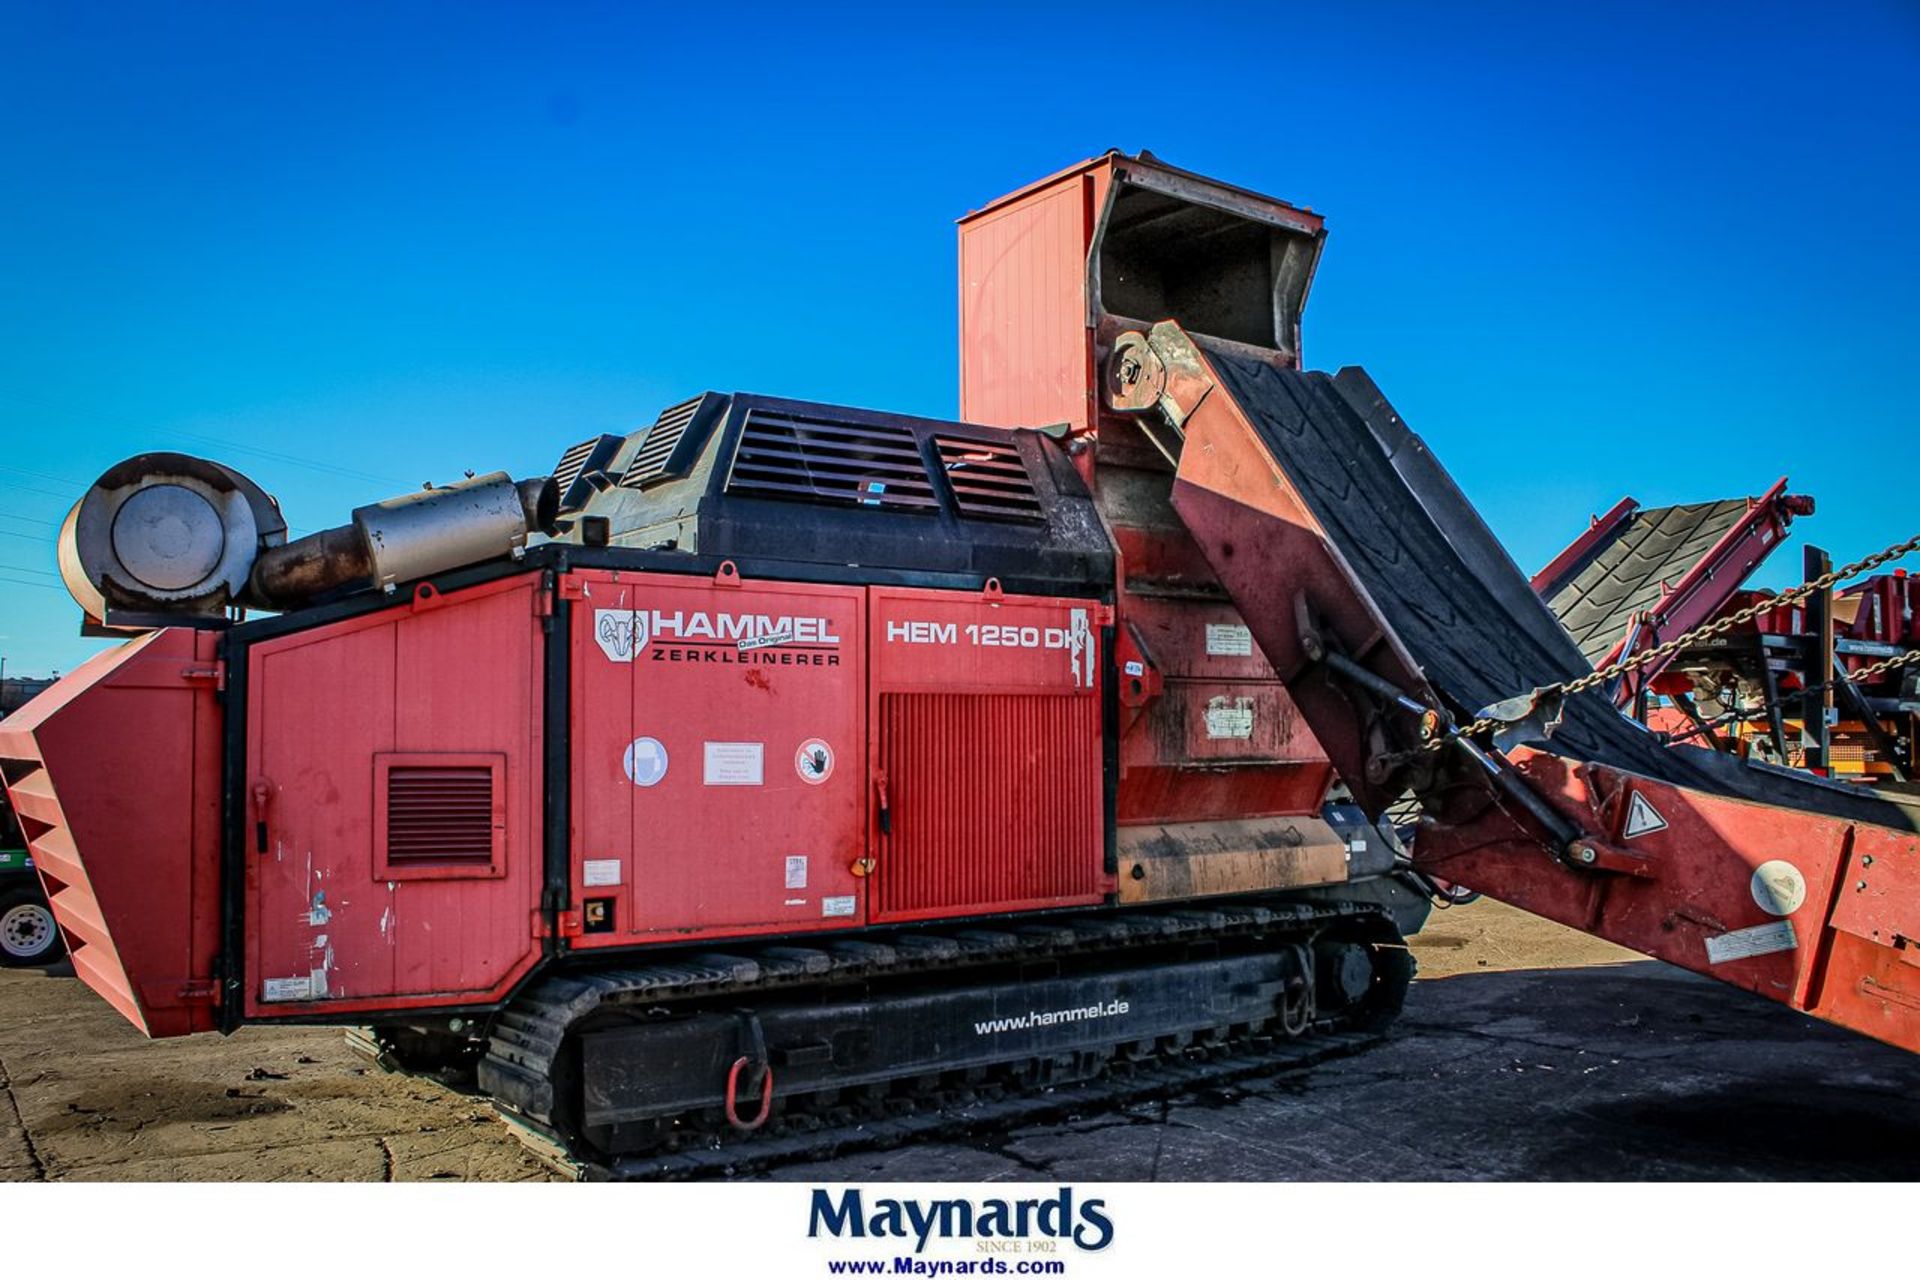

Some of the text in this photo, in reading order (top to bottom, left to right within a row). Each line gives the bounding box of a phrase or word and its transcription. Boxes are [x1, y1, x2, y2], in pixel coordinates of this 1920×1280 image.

[652, 610, 840, 643] HAMMEL
[887, 621, 957, 645] HEM
[965, 624, 1038, 648] 1250
[740, 634, 791, 648] Das Original
[652, 649, 840, 666] ZERKLEINERER
[976, 1000, 1129, 1035] www.hammel.de
